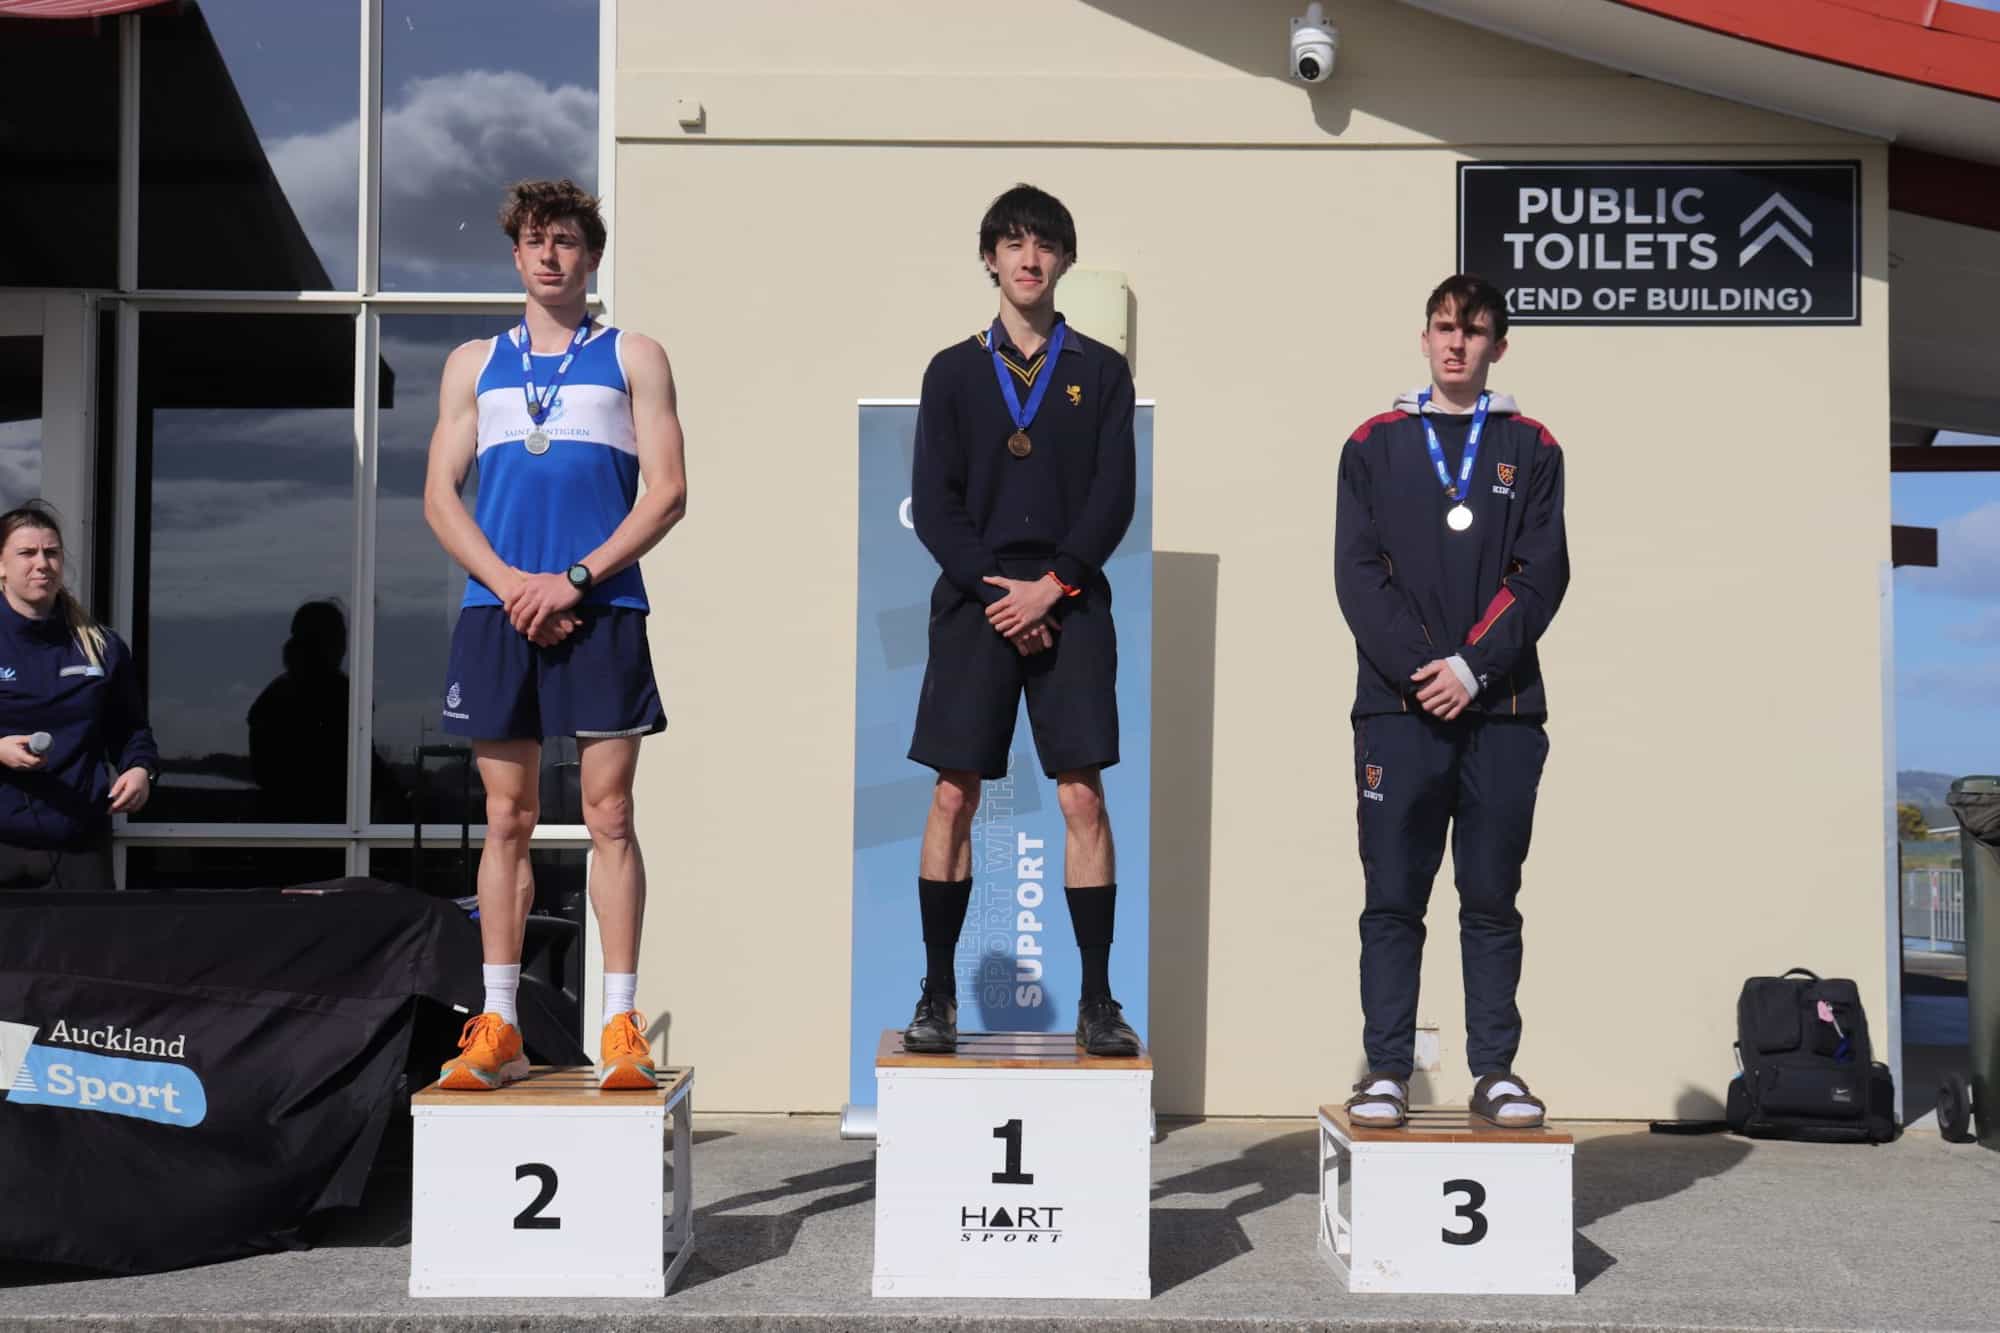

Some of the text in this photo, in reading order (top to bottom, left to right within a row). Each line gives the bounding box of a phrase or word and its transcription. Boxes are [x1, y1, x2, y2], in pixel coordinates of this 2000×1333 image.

[1518, 187, 1705, 225] PUBLIC
[1503, 233, 1718, 271] TOILETS
[1505, 288, 1813, 314] (END OF BUILDING)
[983, 881, 1014, 1009] SPORT
[1015, 831, 1045, 1008] SUPPORT
[48, 1019, 186, 1059] Auckland
[47, 1063, 183, 1115] Sport
[991, 1118, 1034, 1185] 1
[513, 1162, 561, 1230] 2
[1441, 1178, 1489, 1246] 3
[960, 1232, 1064, 1243] SPORT
